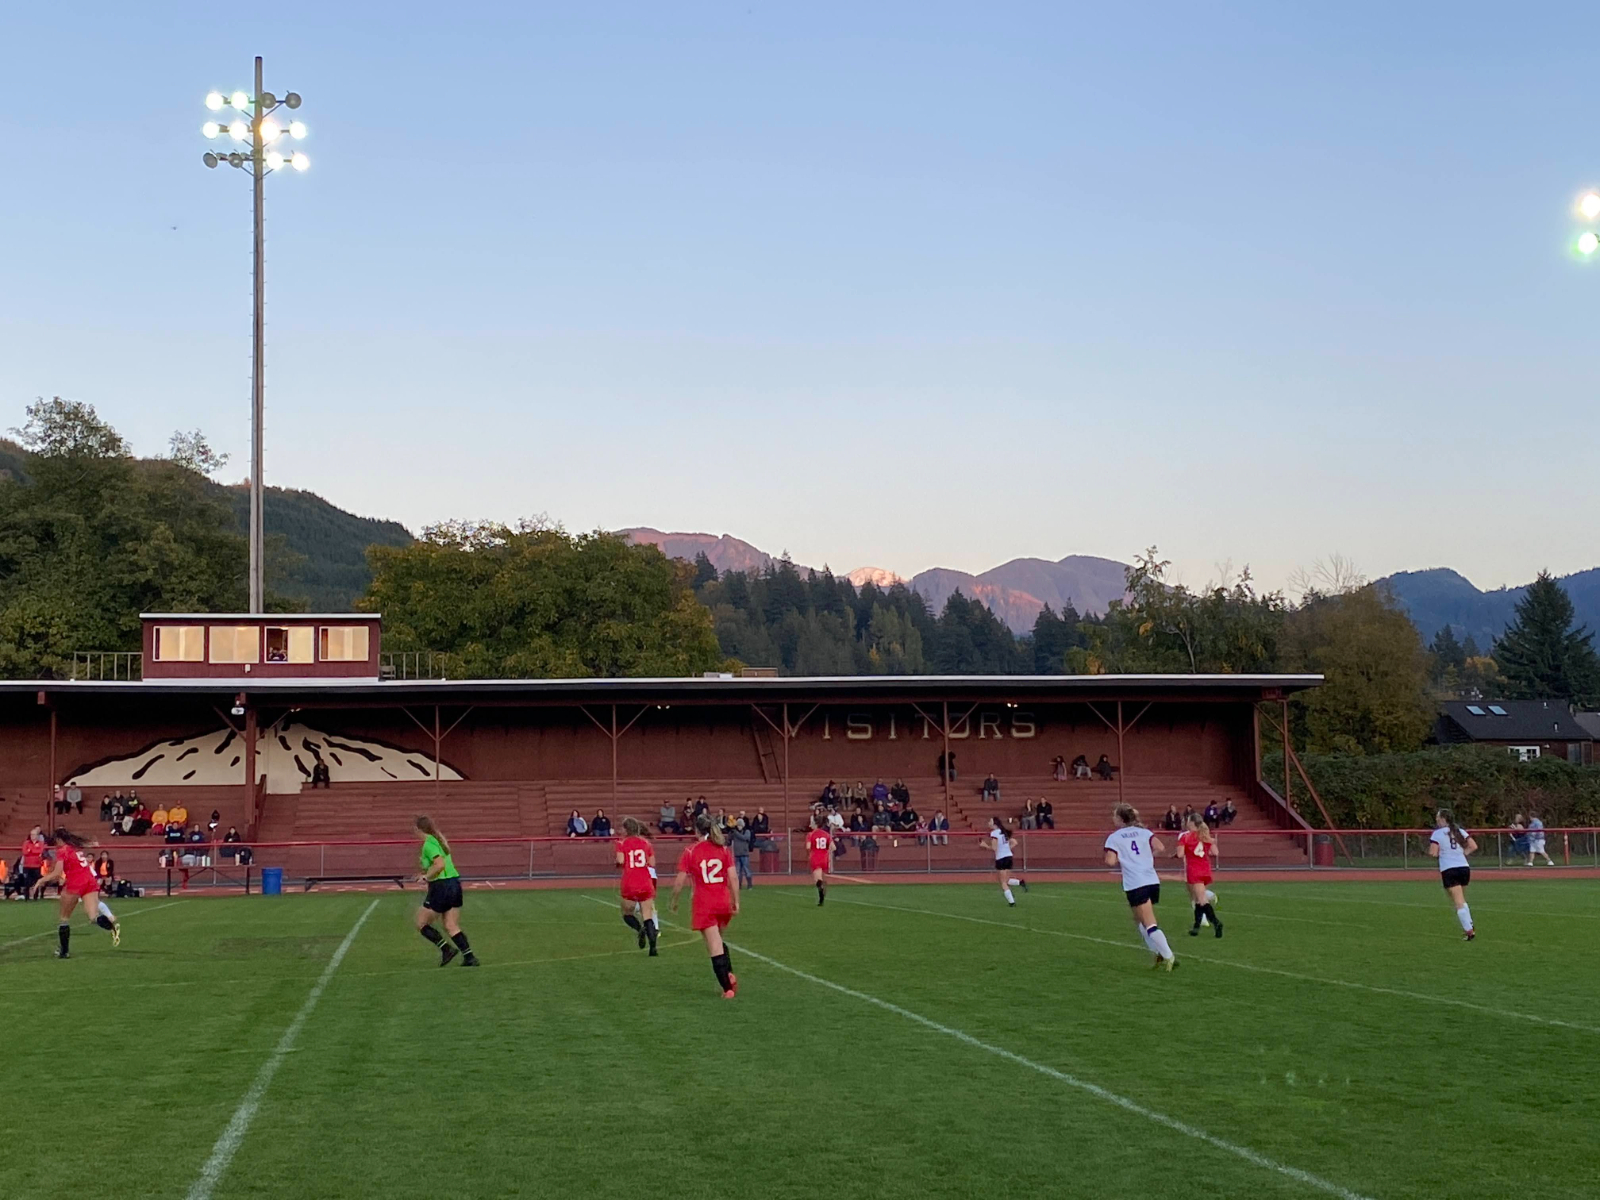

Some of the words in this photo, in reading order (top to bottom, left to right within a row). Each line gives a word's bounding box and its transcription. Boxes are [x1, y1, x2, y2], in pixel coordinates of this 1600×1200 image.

[783, 712, 1036, 740] VISITORS
[815, 837, 827, 849] 18
[1131, 840, 1140, 854] 4
[1194, 841, 1205, 858] 4
[76, 851, 88, 868] 5
[628, 849, 646, 869] 13
[700, 858, 724, 884] 12
